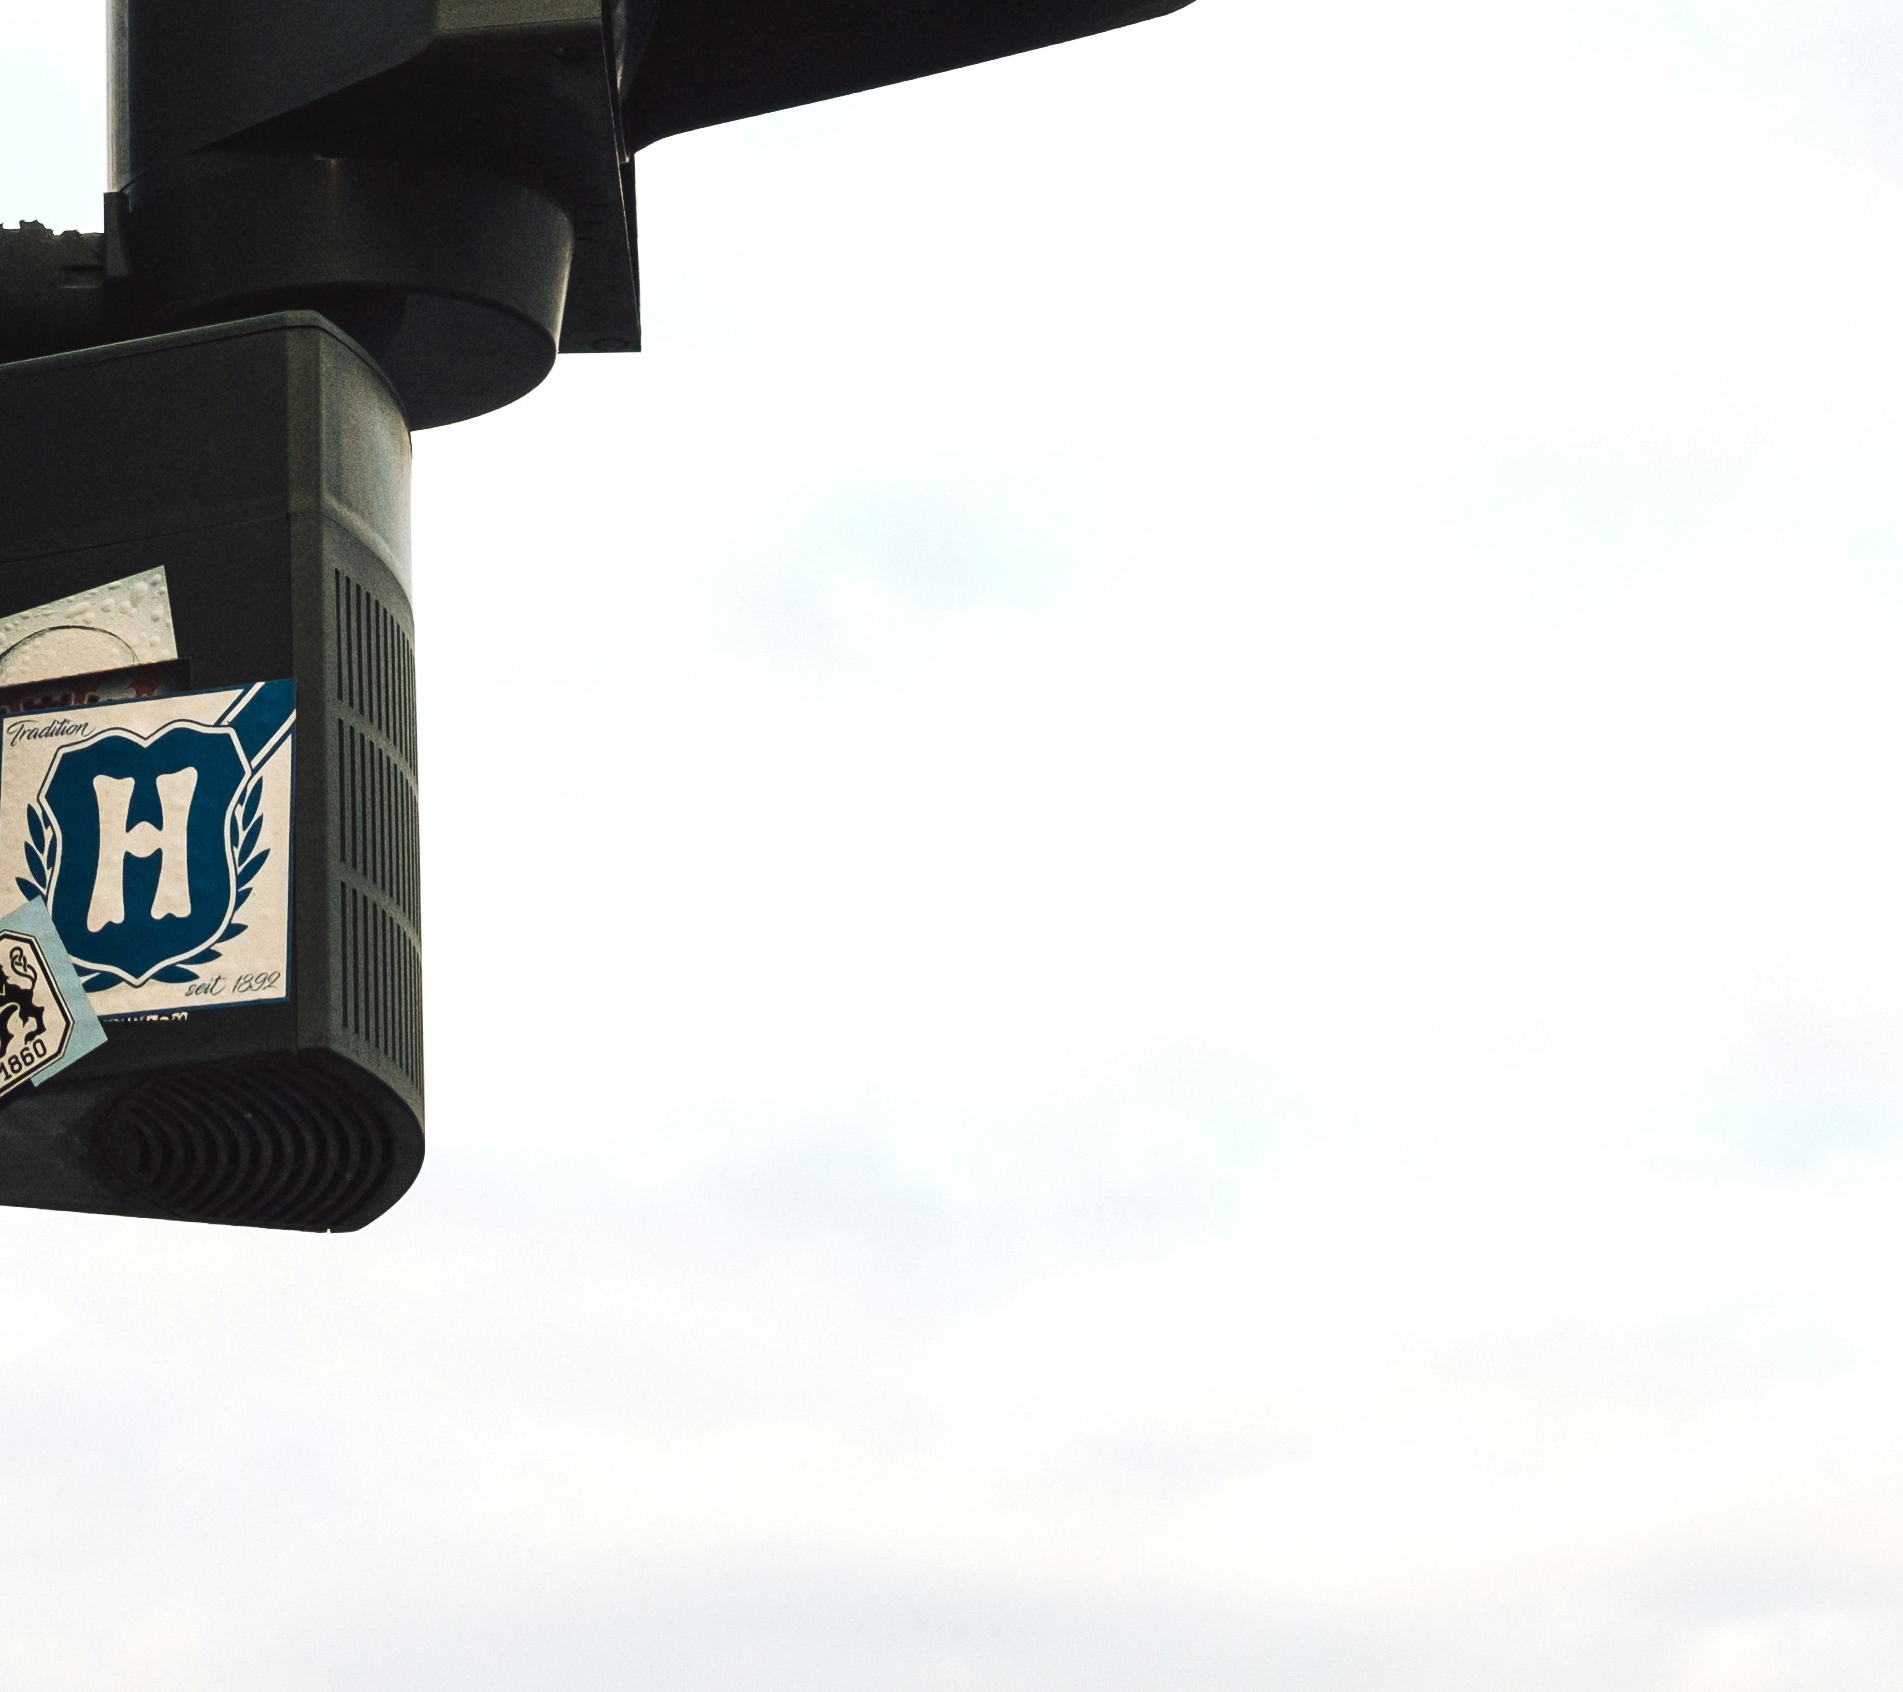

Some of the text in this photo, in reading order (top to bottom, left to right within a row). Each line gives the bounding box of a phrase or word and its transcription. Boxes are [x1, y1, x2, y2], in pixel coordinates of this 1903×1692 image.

[7, 718, 95, 747] Tradition
[86, 766, 198, 933] H
[185, 971, 281, 997] seit 1892
